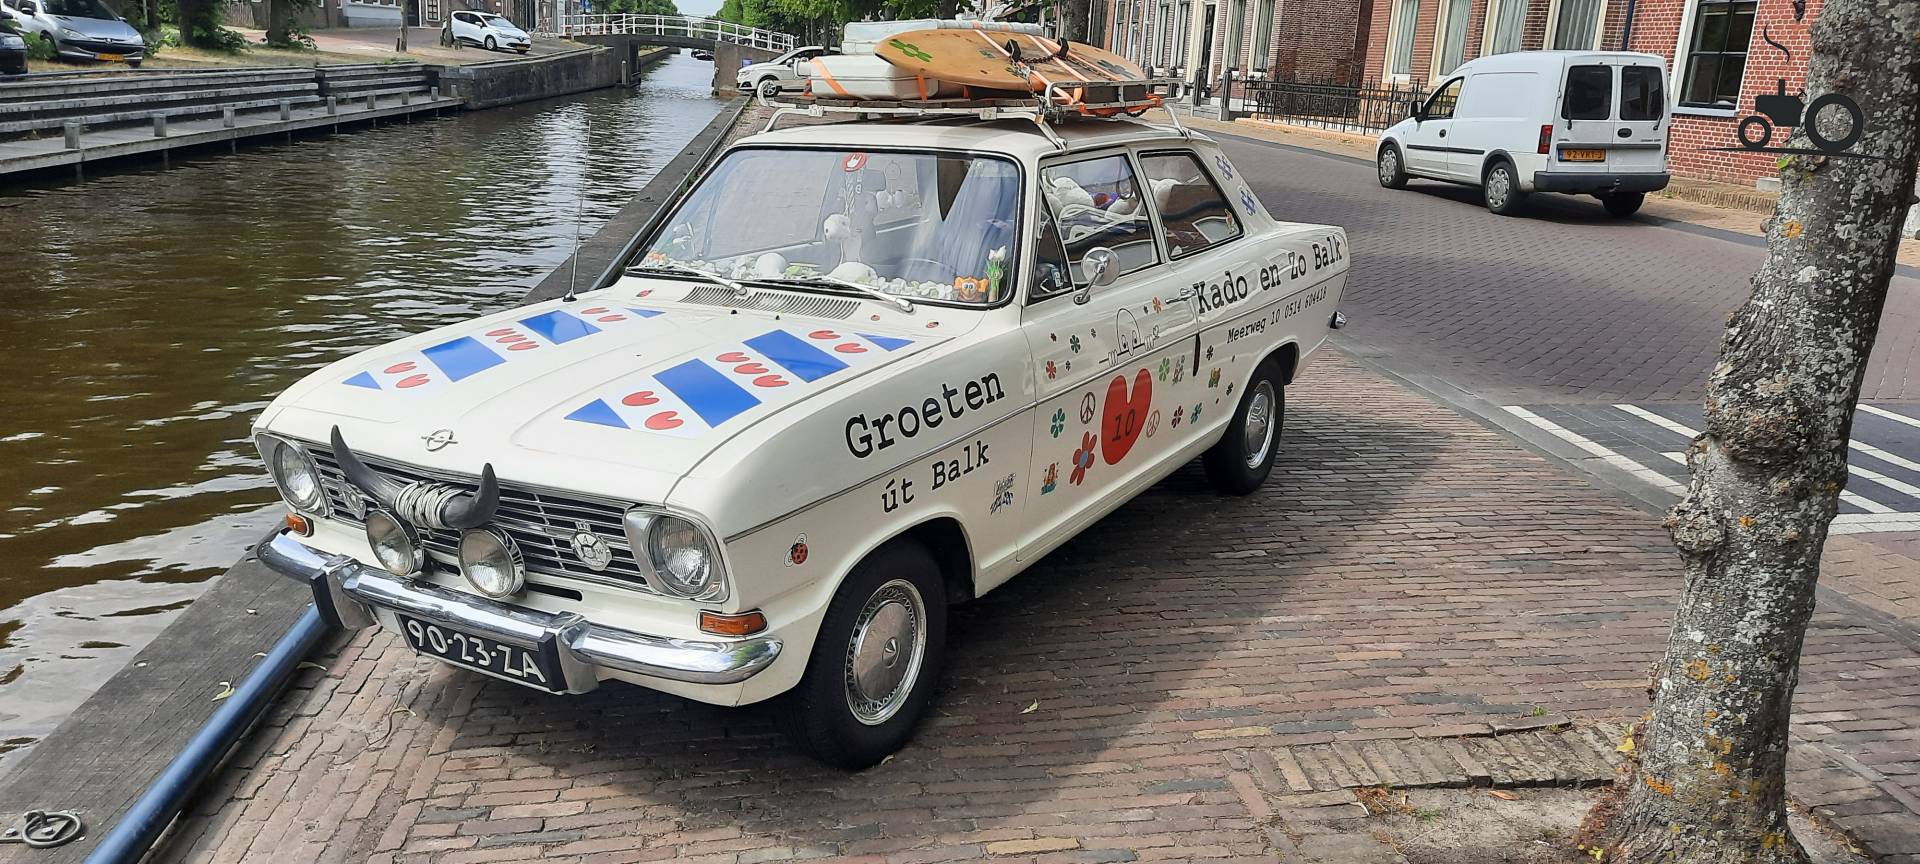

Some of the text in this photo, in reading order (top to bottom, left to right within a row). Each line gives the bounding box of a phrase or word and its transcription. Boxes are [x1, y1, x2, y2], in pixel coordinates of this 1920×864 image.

[1193, 236, 1343, 314] Kado en Zo Balk
[1226, 317, 1267, 345] Meerweg
[1270, 308, 1281, 326] 10
[1284, 299, 1302, 320] 0514
[845, 372, 1005, 459] Groeten
[1111, 408, 1136, 442] 10
[881, 440, 990, 513] út Balk
